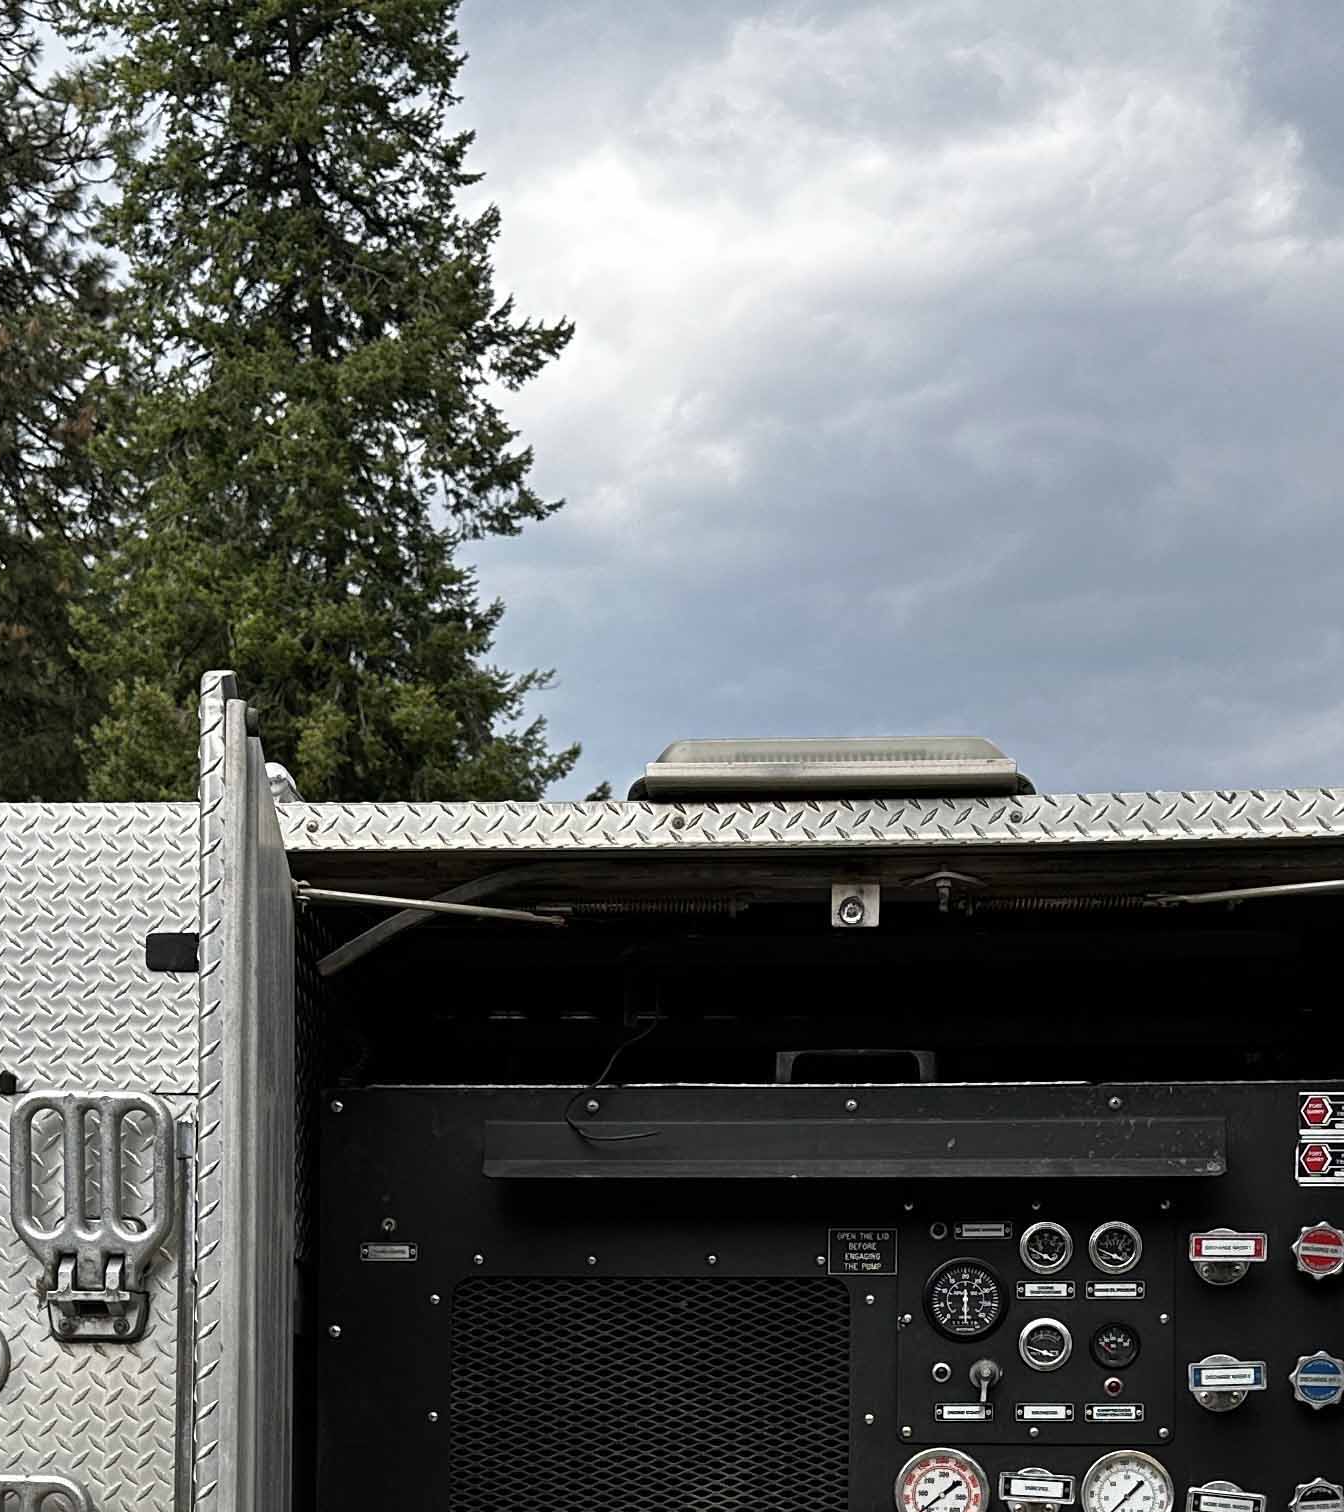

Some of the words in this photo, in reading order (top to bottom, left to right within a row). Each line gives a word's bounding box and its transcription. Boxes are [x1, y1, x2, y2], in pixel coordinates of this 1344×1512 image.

[836, 1232, 857, 1240] OPEN
[860, 1232, 873, 1240] THE
[876, 1232, 890, 1240] LID
[848, 1242, 877, 1251] BEFORE
[844, 1252, 881, 1261] ENGAGING
[843, 1262, 859, 1271] THE
[862, 1262, 882, 1271] PUMP
